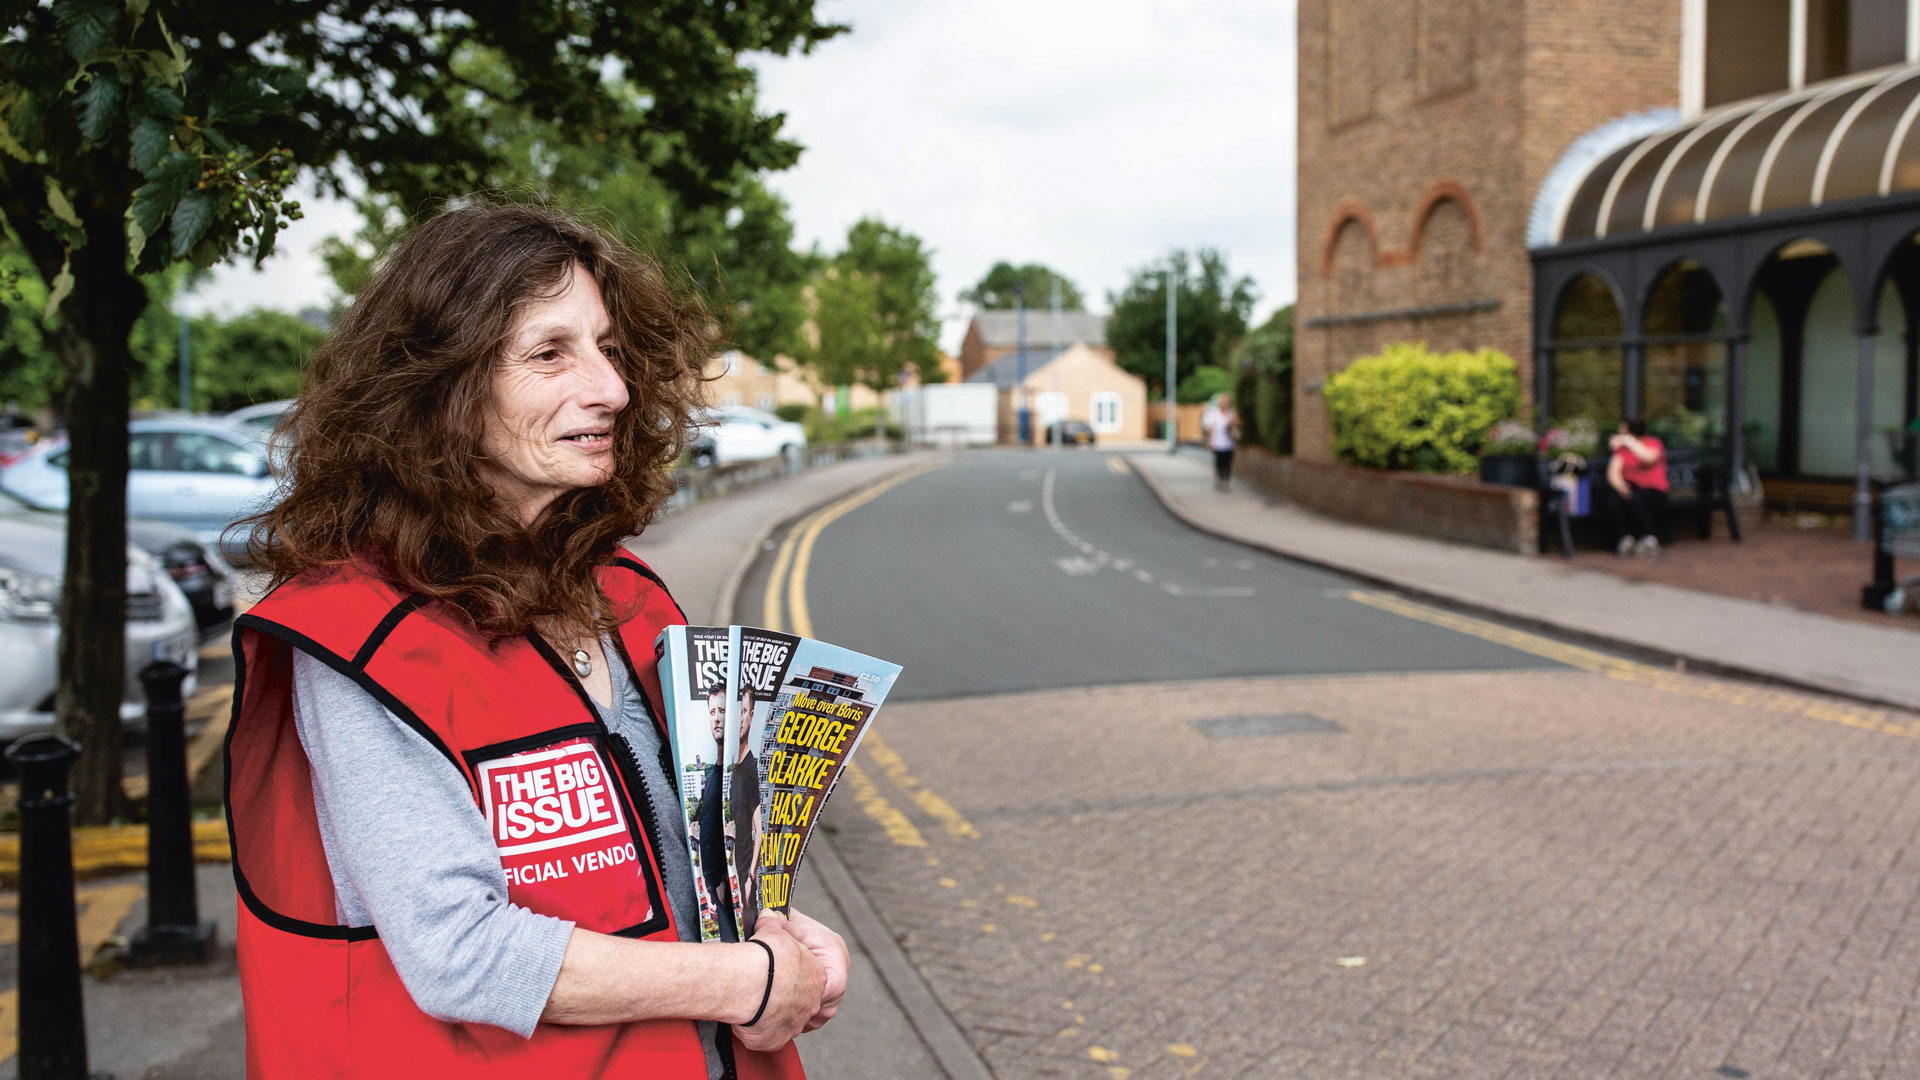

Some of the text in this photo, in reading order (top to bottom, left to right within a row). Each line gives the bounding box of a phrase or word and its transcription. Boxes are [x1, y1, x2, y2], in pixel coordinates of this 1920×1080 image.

[694, 640, 729, 661] THE
[742, 640, 789, 666] THE BIG
[695, 661, 728, 689] ISS
[740, 662, 782, 691] ISSUE
[860, 672, 880, 683] £2.50
[792, 692, 864, 721] Move over Boris
[777, 711, 855, 754] GEORGE
[495, 758, 601, 803] THE BIG
[768, 750, 835, 790] CLARKE
[498, 785, 612, 841] ISSUE
[771, 792, 815, 827] HAS A
[503, 842, 637, 887] FICIAL VENDO
[761, 832, 801, 867] PLAN TO
[761, 873, 790, 909] REBUILD
